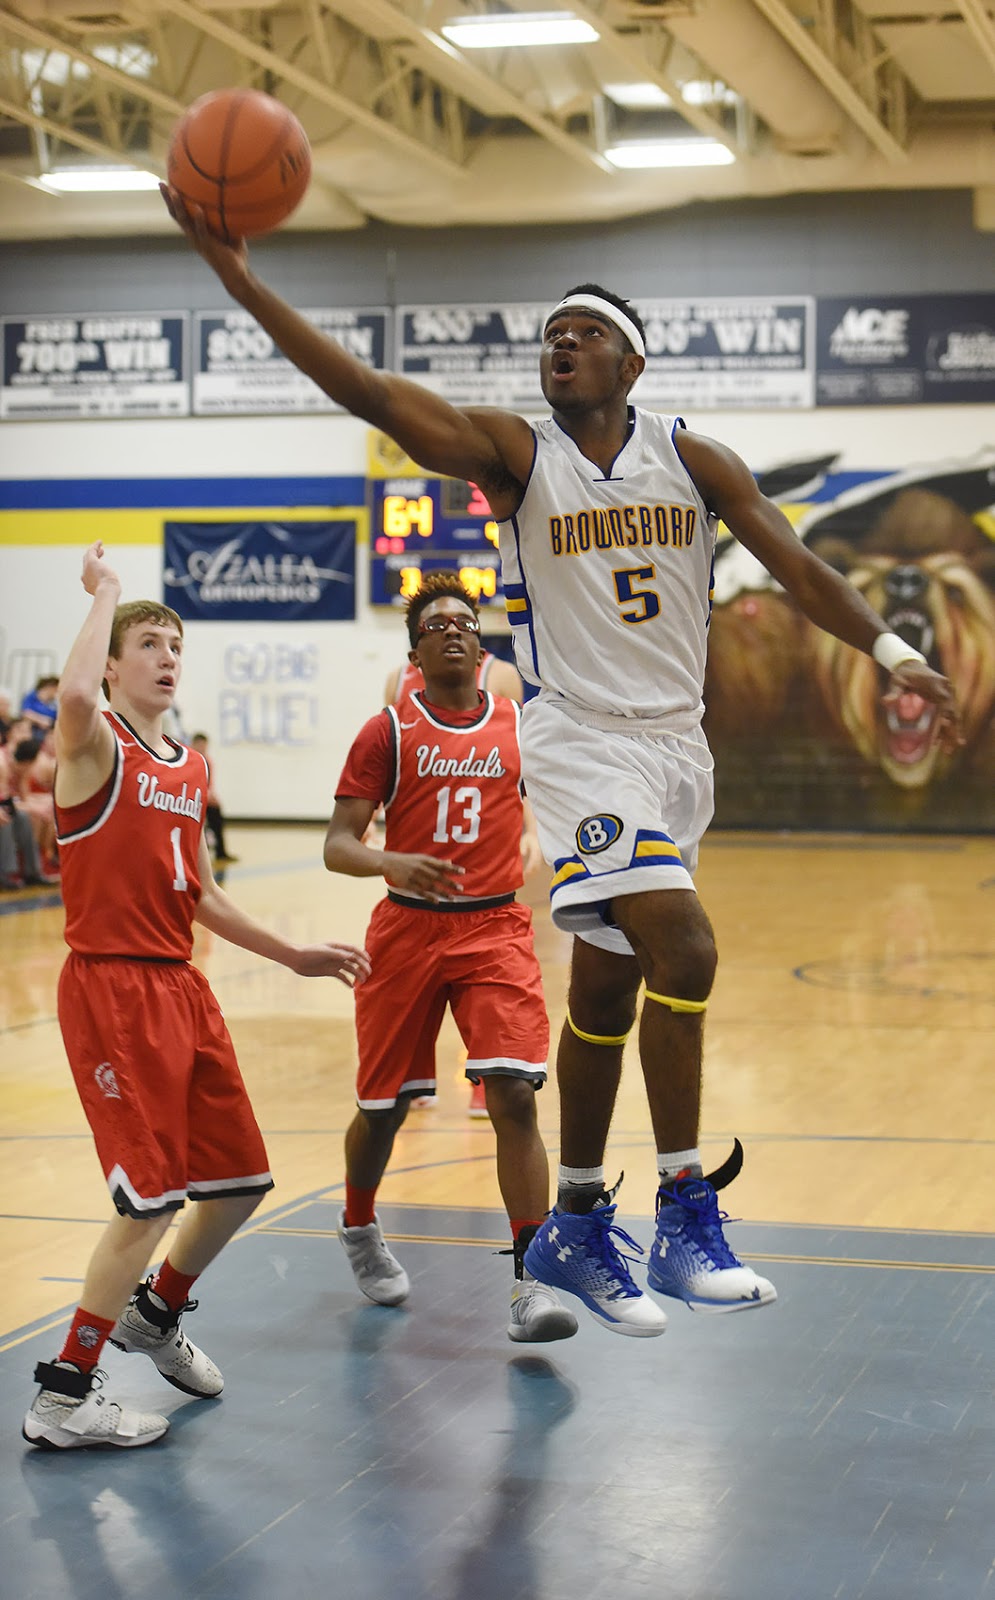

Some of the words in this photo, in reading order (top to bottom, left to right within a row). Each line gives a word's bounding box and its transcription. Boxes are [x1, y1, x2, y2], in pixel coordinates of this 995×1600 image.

[711, 318, 800, 354] WIN
[831, 308, 909, 342] ACE
[104, 338, 171, 370] WIN
[383, 495, 433, 537] 64
[550, 504, 697, 557] BROWNSBORO
[612, 562, 661, 625] 5
[223, 642, 271, 684] GO
[416, 744, 506, 778] Vandals
[433, 786, 483, 844] 13
[583, 818, 609, 849] B
[170, 826, 189, 892] 1
